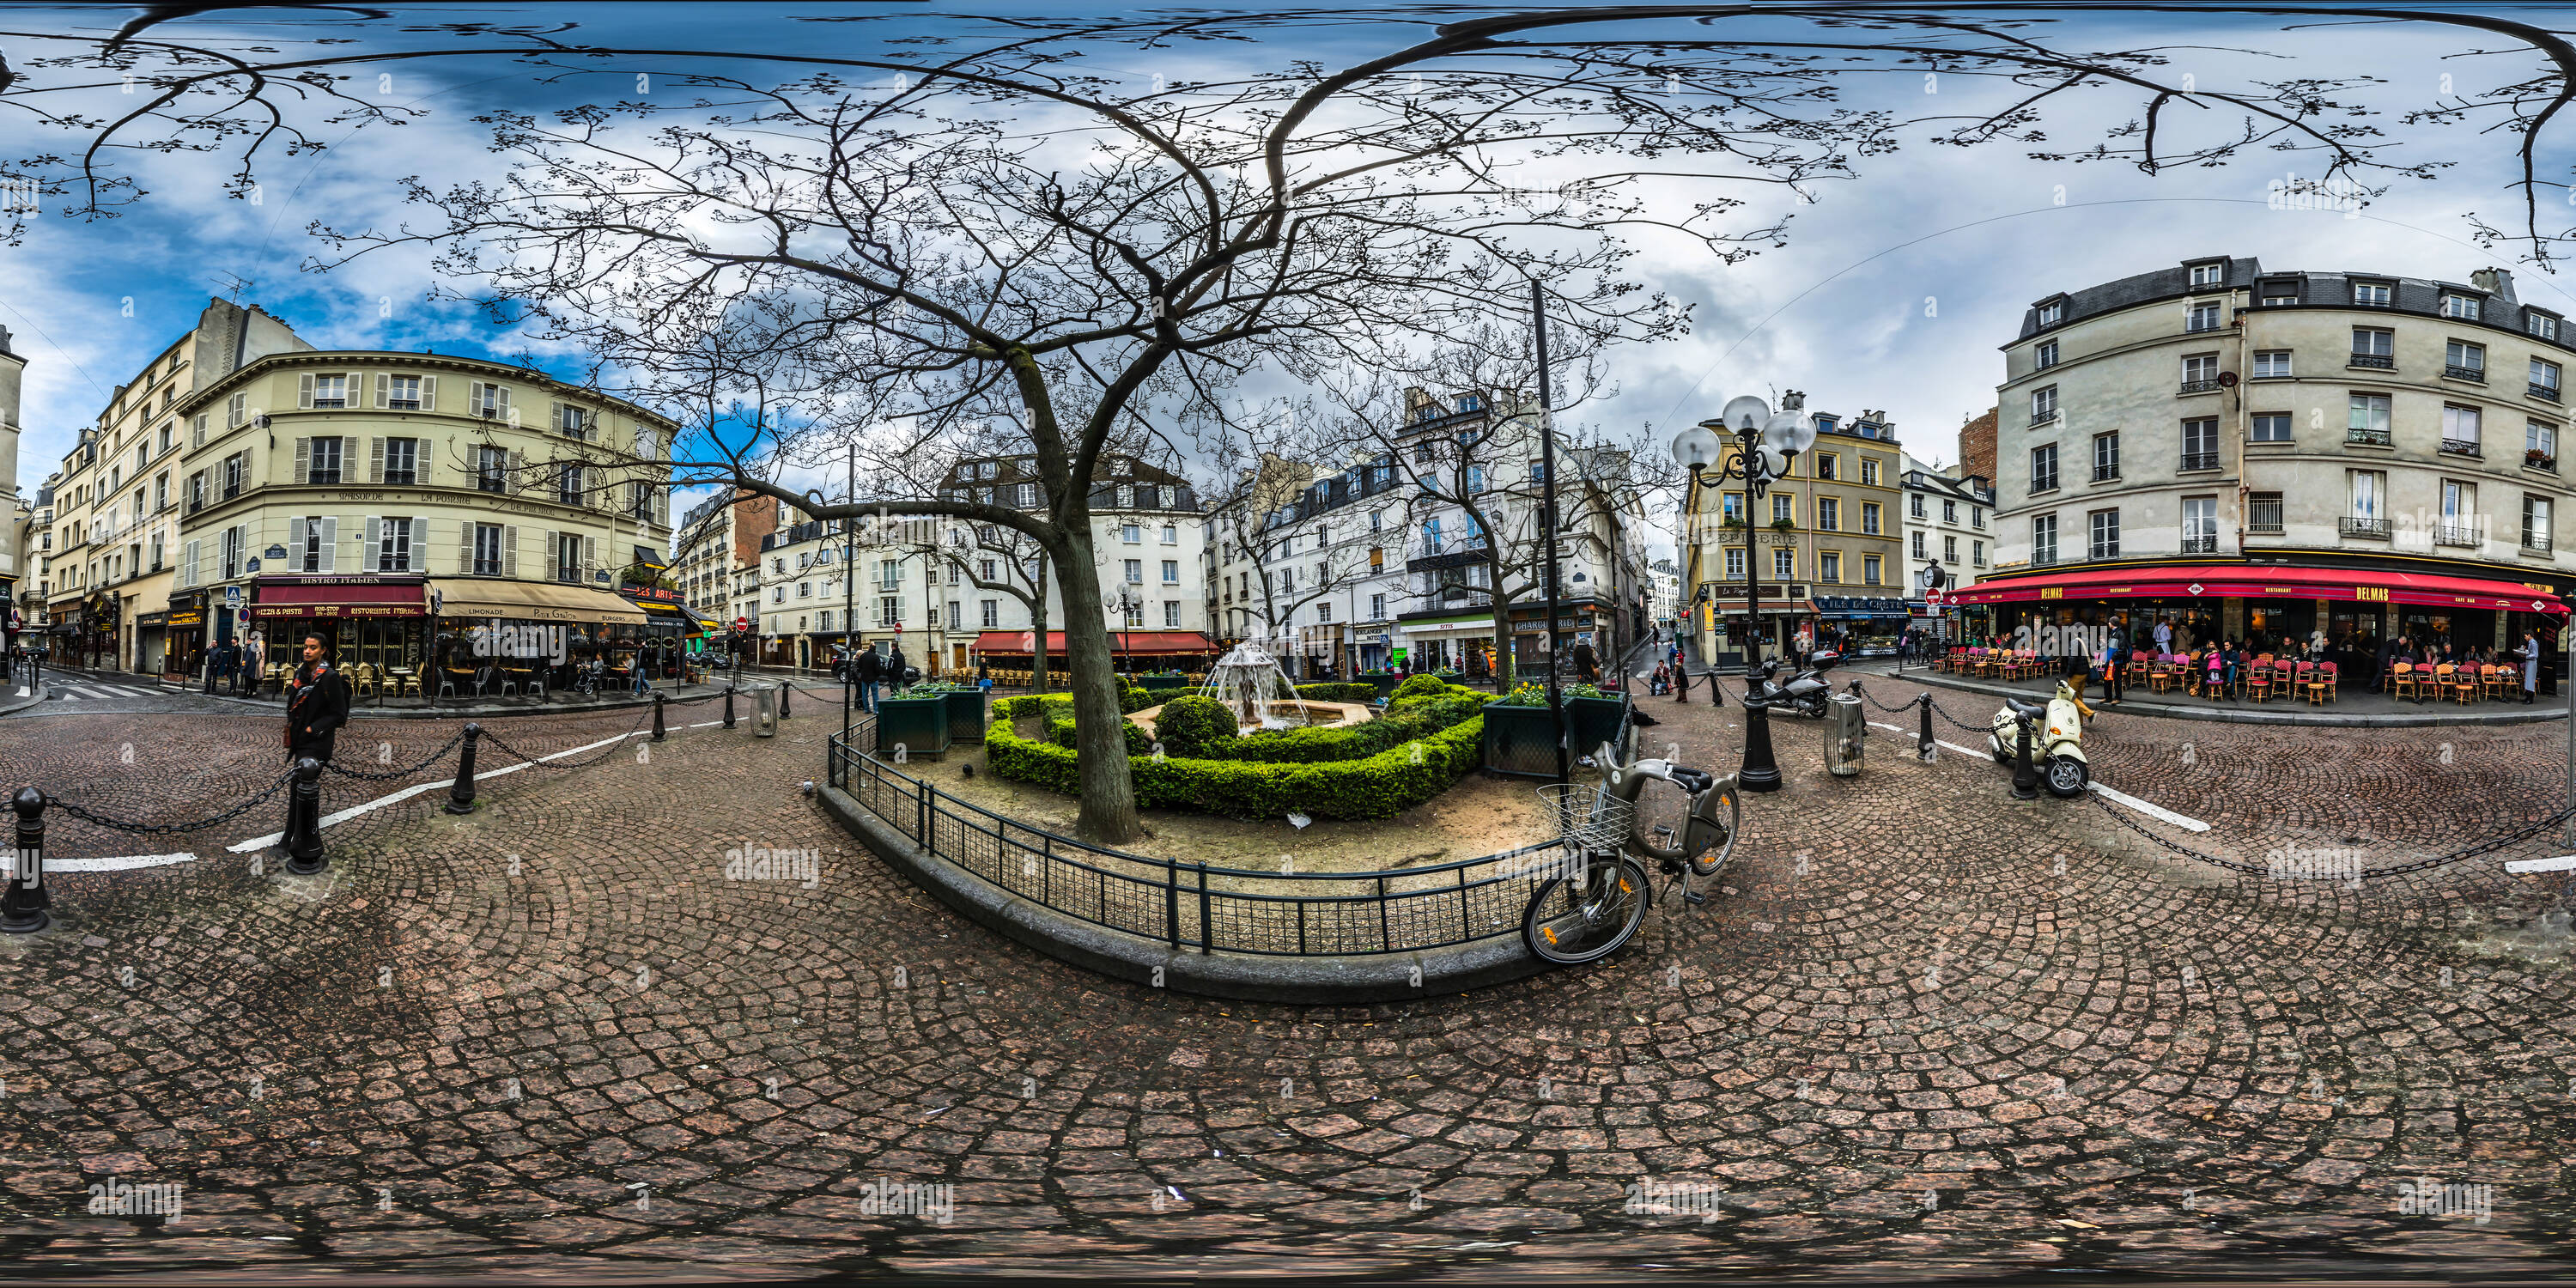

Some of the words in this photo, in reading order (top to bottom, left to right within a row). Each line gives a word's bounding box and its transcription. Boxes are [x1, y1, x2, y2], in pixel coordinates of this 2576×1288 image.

[1718, 533, 1797, 544] EPIERIE
[655, 589, 673, 600] ARTS
[2041, 587, 2063, 599] DELMAS
[2356, 586, 2388, 601] DELMAS
[1516, 618, 1573, 630] CHARCURIE
